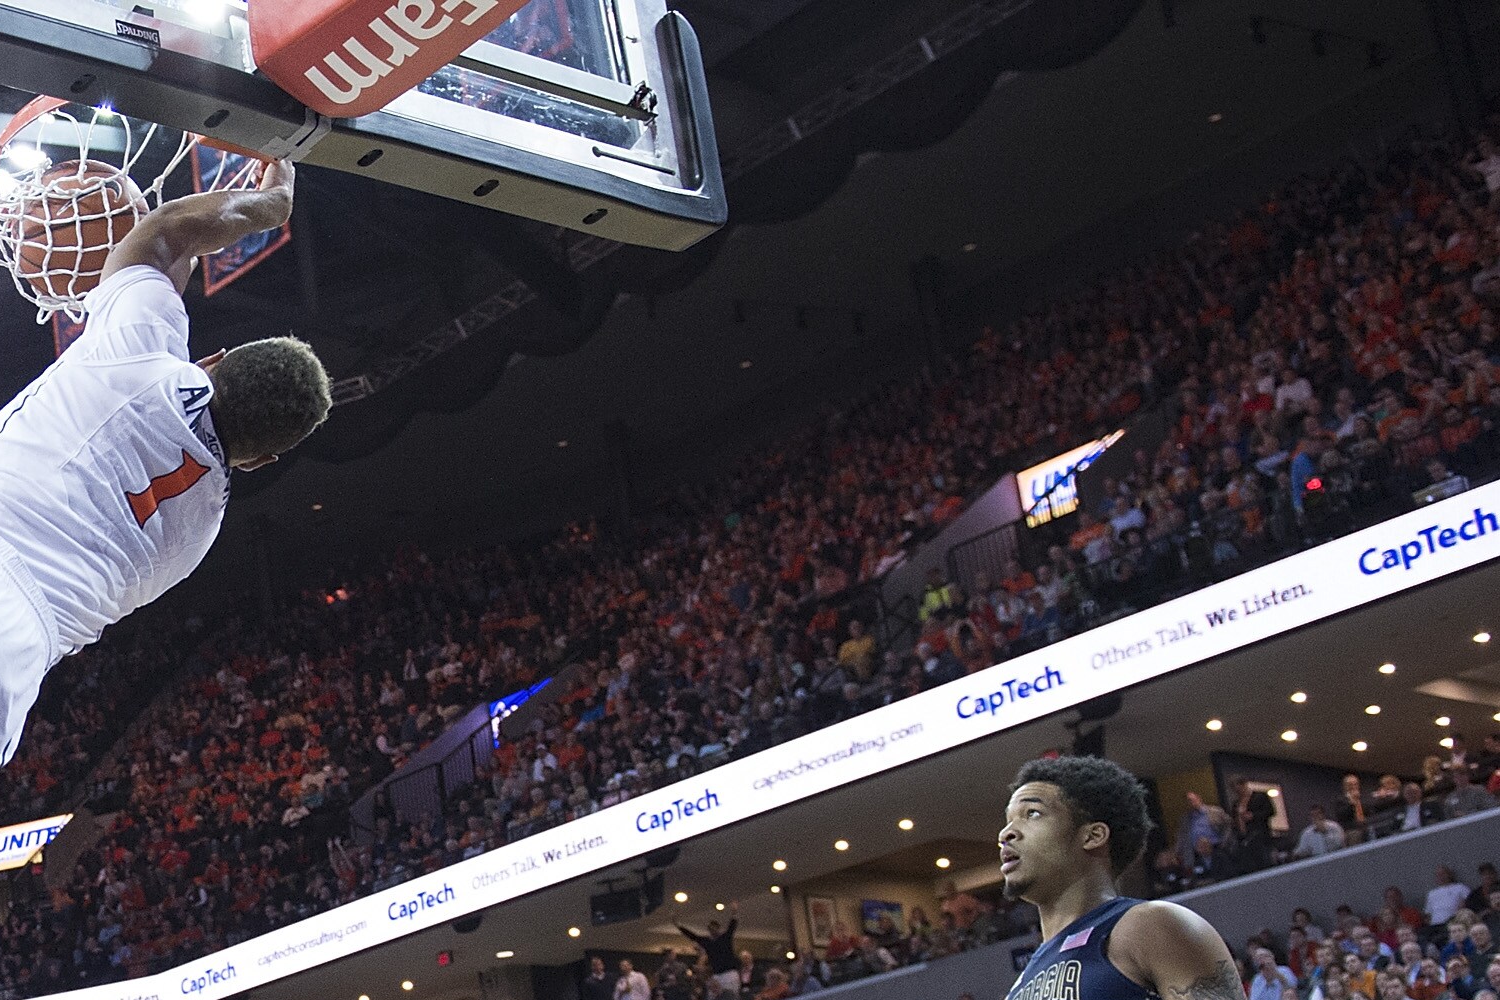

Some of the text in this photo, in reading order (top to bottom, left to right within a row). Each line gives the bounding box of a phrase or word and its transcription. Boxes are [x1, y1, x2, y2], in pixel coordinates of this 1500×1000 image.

[115, 22, 160, 44] SPALDING
[124, 448, 211, 530] 1
[1358, 507, 1500, 576] CapTech
[1091, 584, 1313, 671] Others Talk, We Listen.
[955, 664, 1065, 721] CapTech
[752, 719, 924, 792] captechconsulting.com
[635, 788, 720, 833] CapTech
[471, 832, 608, 890] Others Talk, We Listen.
[387, 882, 456, 921] CapTech
[257, 919, 367, 968] captechconsulting.com
[180, 961, 237, 995] CapTech
